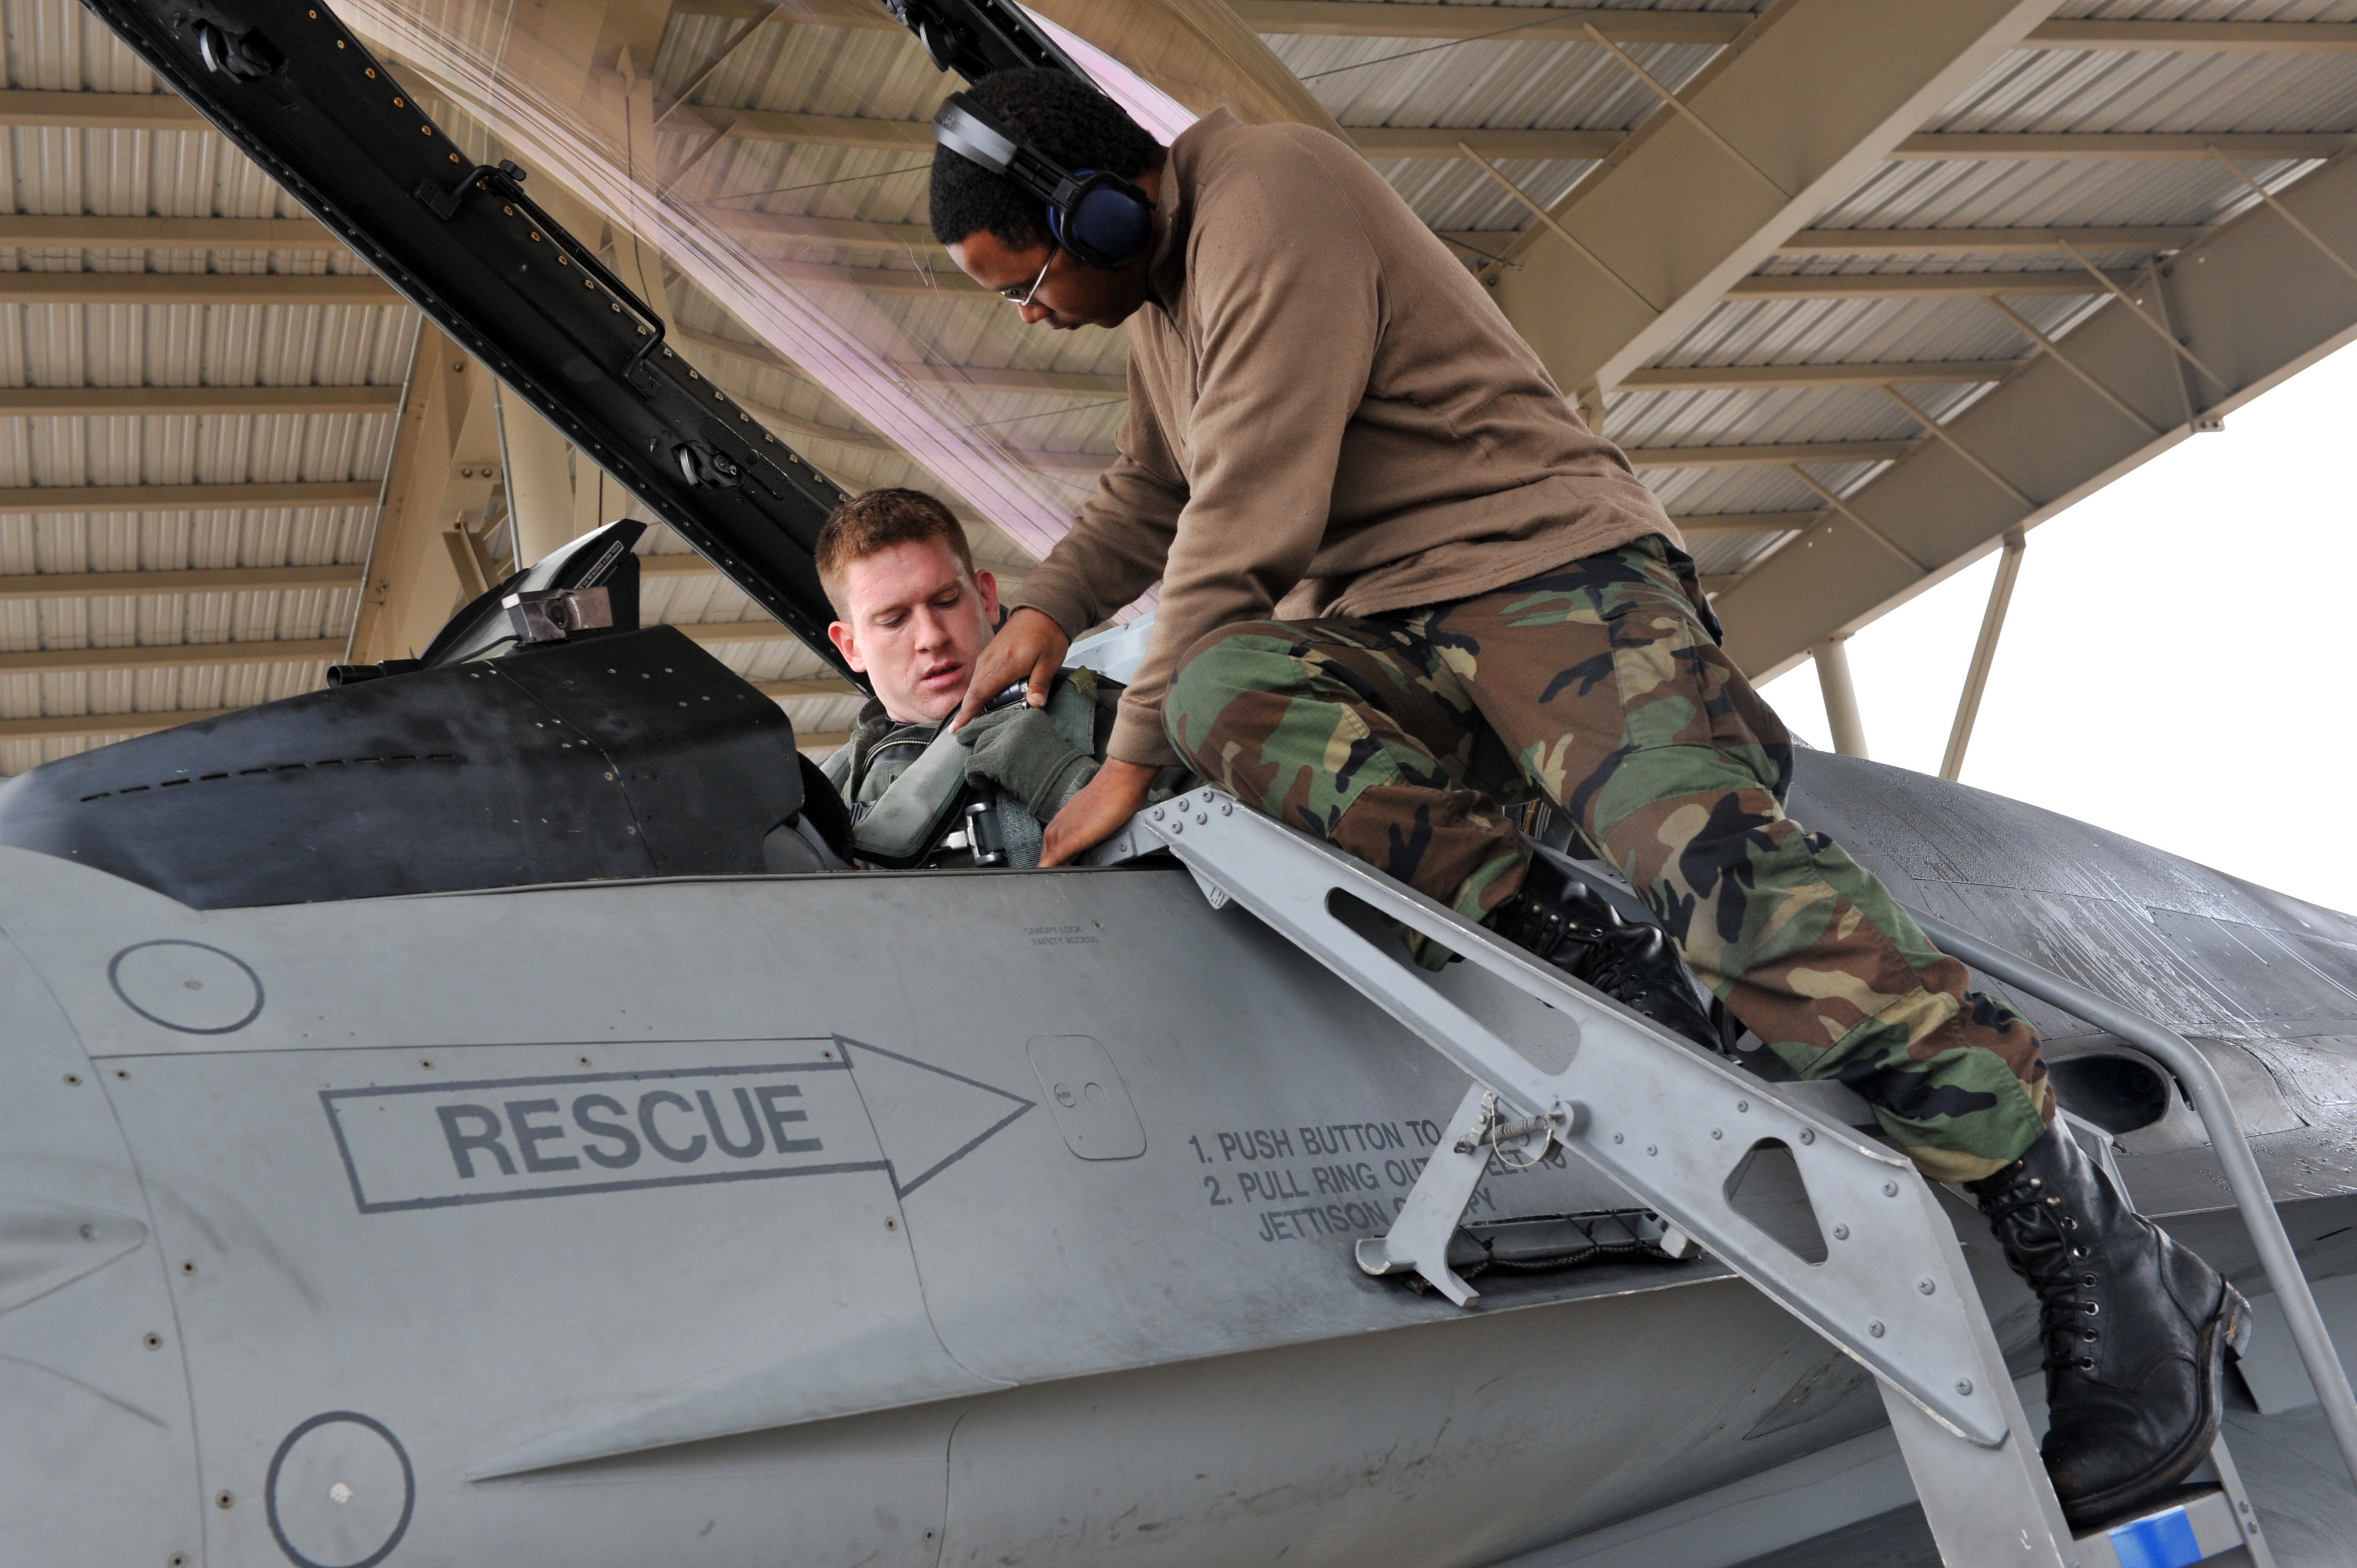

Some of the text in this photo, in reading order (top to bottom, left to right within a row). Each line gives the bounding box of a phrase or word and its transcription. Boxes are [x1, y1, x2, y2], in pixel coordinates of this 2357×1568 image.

[436, 1085, 823, 1178] RESCUE
[1188, 1120, 1442, 1163] 1. PUSH BUTTON TO
[1203, 1175, 1233, 1205] 2.
[1237, 1169, 1309, 1203] PULL
[1311, 1163, 1381, 1194] RING
[1259, 1196, 1391, 1242] JETTISON
